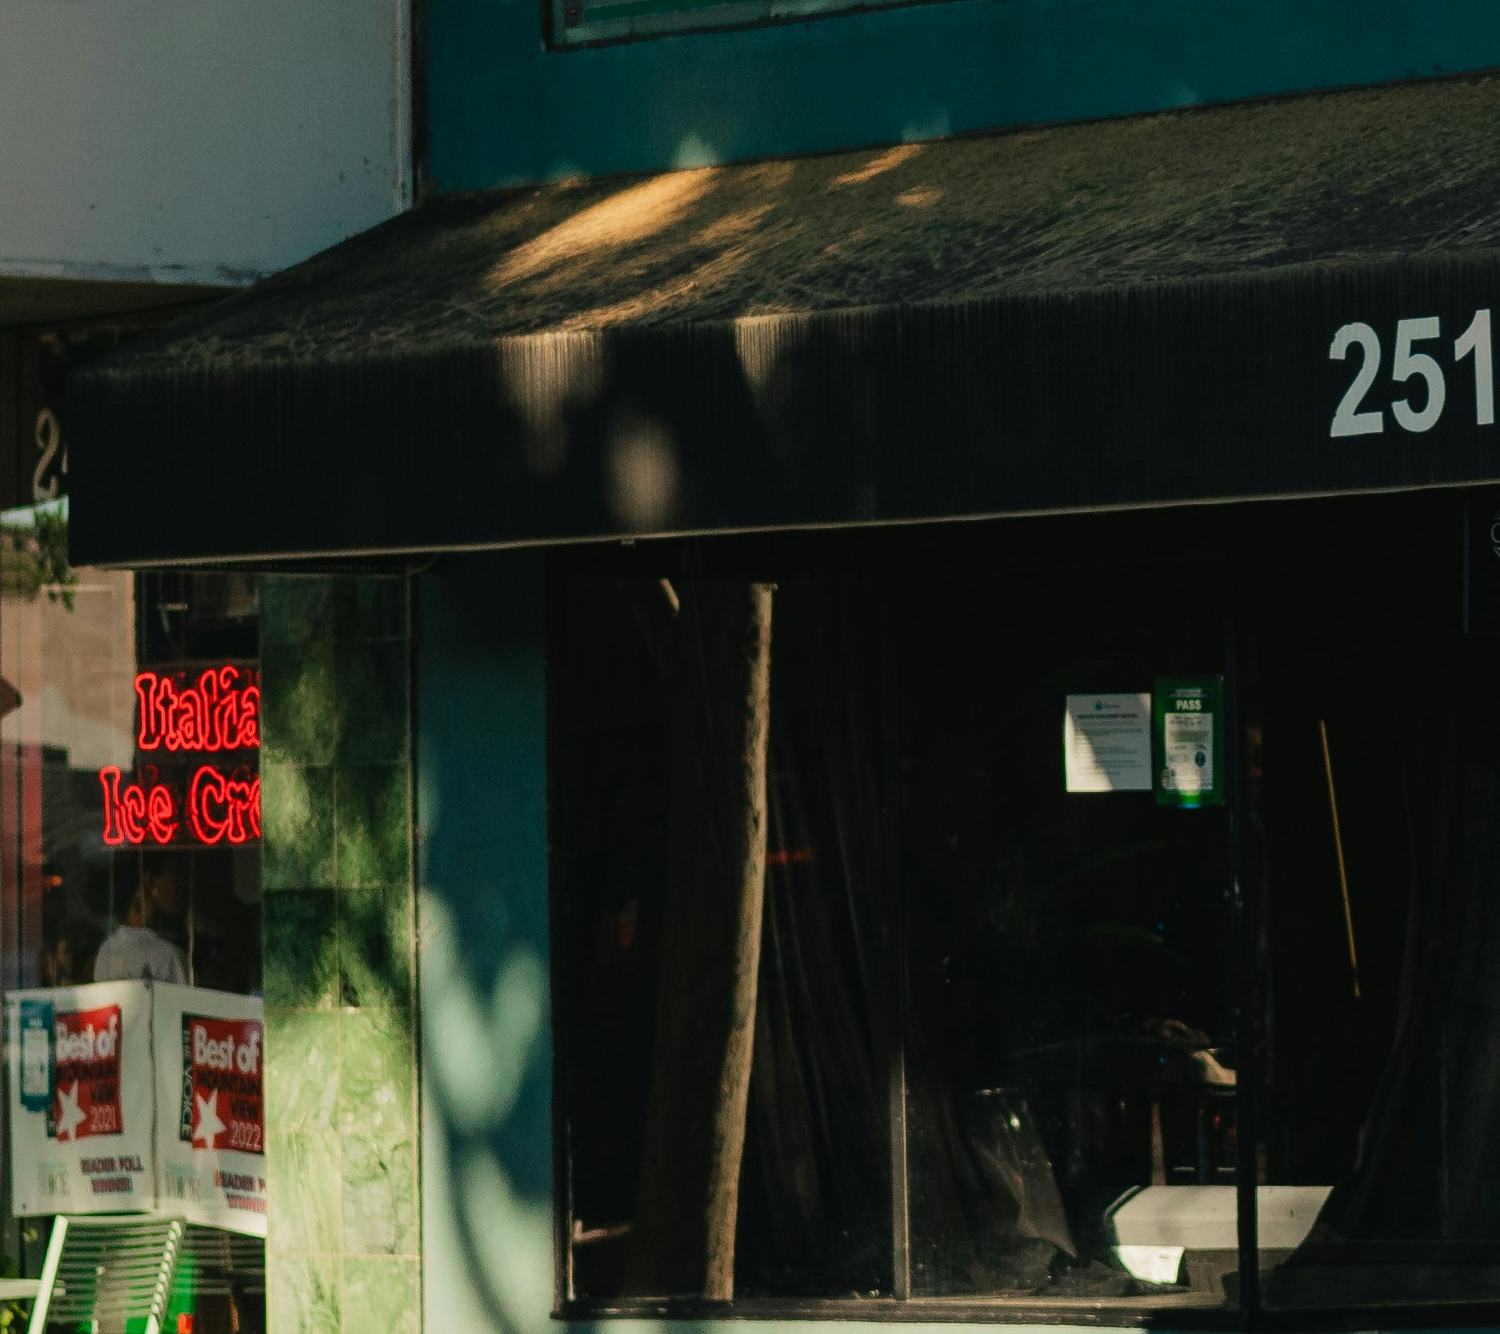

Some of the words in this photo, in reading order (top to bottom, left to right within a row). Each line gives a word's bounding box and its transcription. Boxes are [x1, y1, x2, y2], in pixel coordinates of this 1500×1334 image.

[1329, 308, 1495, 438] 251
[1176, 699, 1202, 711] PASS
[100, 766, 178, 845] Ice
[194, 1024, 235, 1071] Best
[236, 1030, 260, 1075] of
